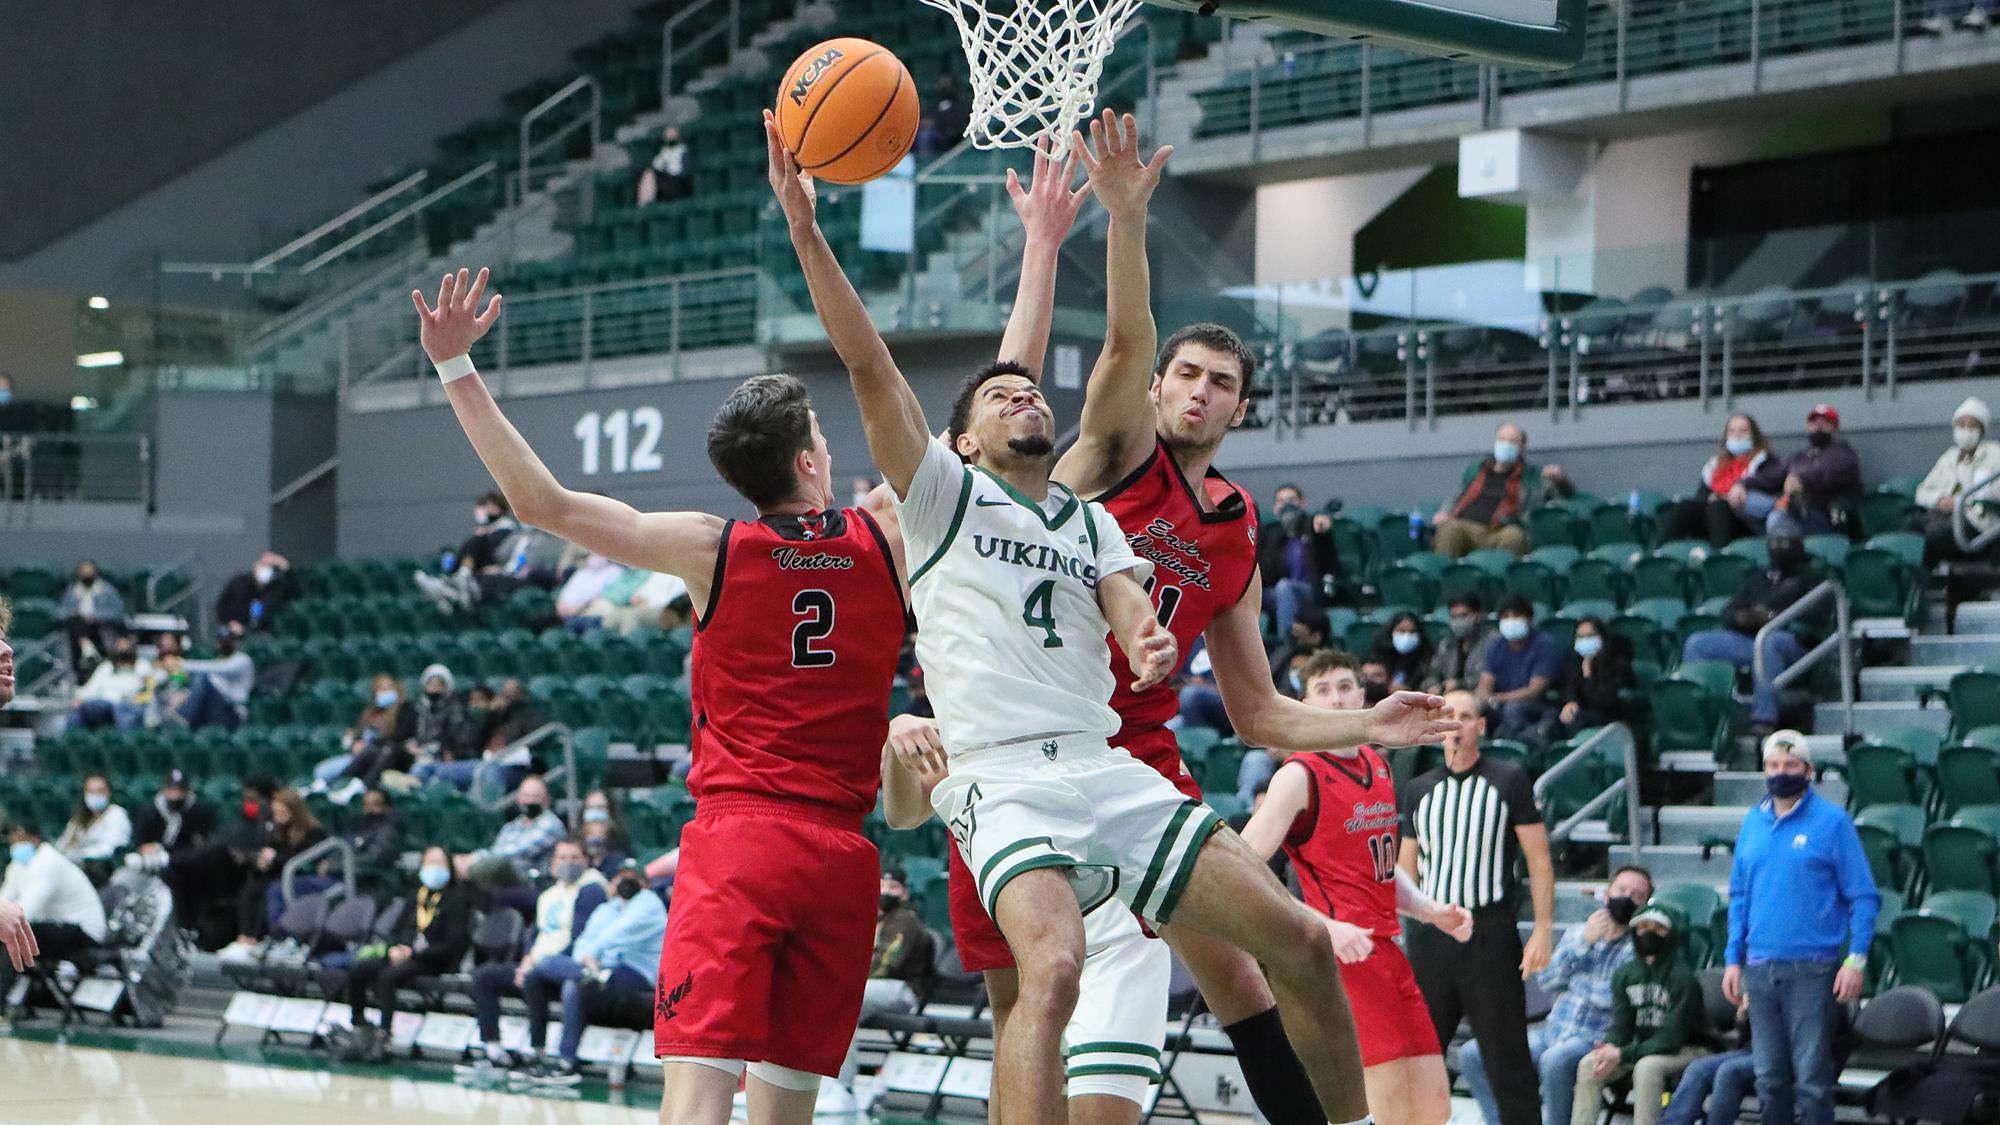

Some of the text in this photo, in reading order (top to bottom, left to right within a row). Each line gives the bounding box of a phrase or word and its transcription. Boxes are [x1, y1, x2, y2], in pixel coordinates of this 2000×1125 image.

[790, 47, 845, 108] NCAA
[574, 406, 663, 475] 112
[772, 546, 854, 570] Venters
[1146, 517, 1211, 572] Easte
[791, 588, 836, 668] 2
[1022, 579, 1064, 649] 4
[1368, 832, 1396, 884] 10
